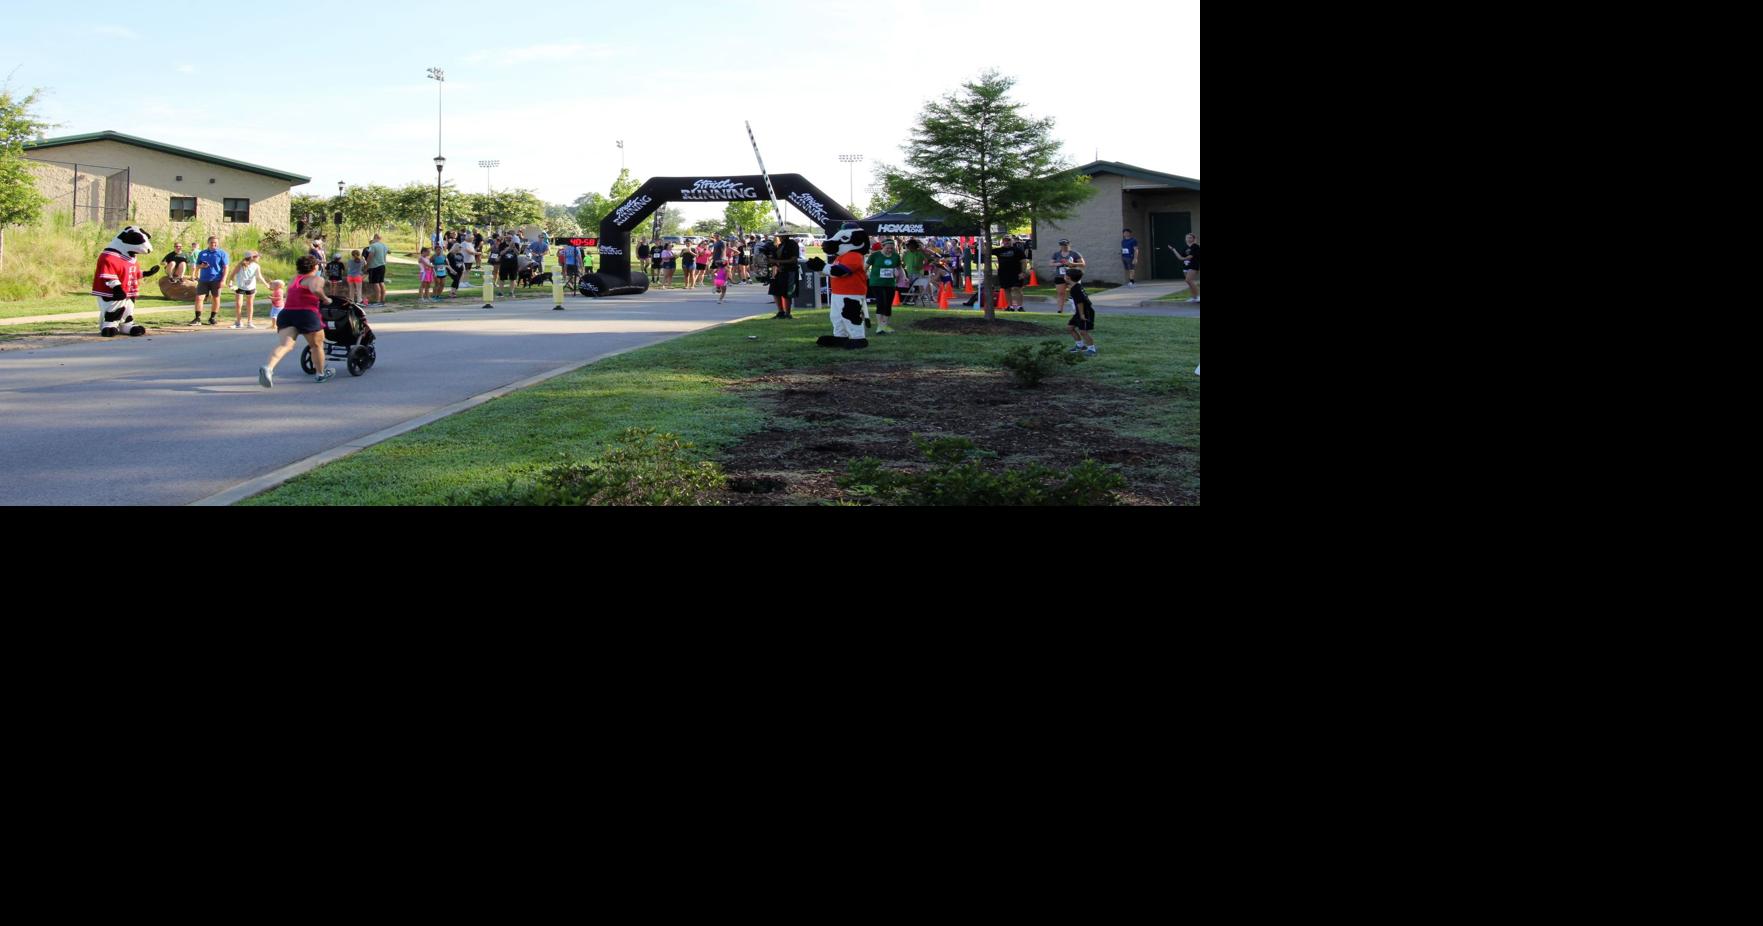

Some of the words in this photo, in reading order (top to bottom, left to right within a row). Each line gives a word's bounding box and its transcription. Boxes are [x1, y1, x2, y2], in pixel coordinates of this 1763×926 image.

[692, 179, 744, 191] Strictly
[680, 187, 758, 200] RUNNING
[877, 223, 911, 233] HOKA
